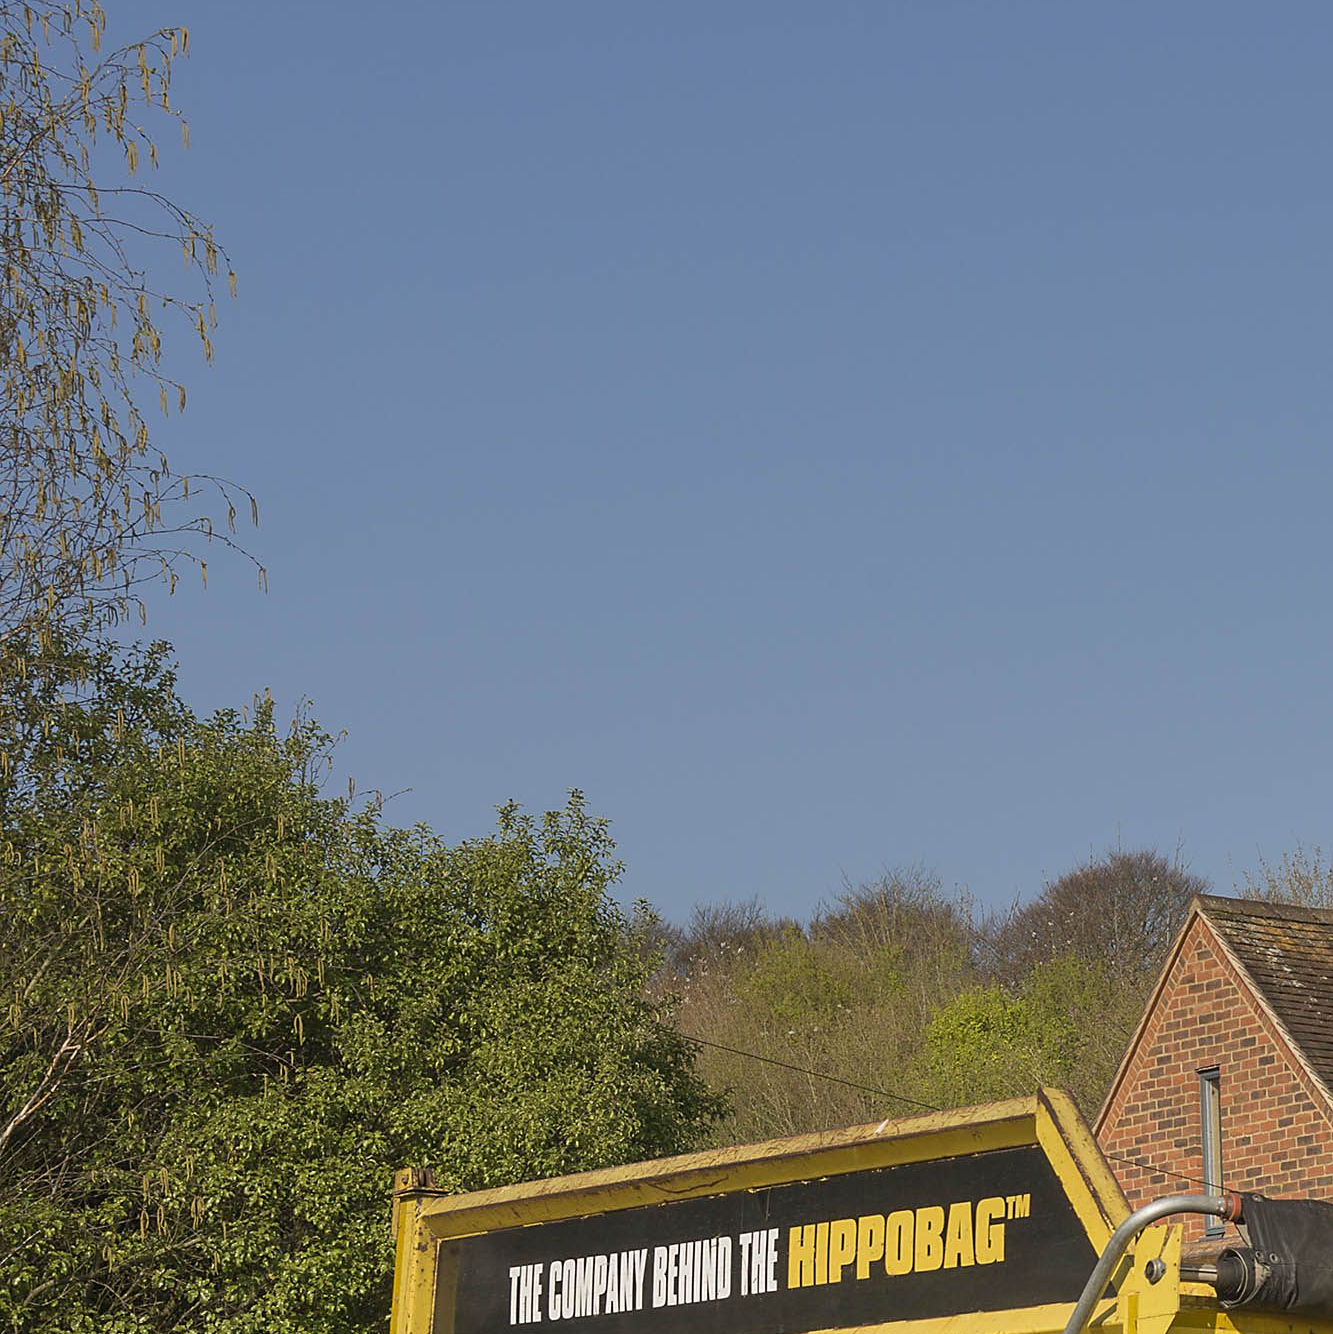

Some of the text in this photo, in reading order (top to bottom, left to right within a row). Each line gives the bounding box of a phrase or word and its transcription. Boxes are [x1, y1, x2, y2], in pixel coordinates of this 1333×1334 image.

[509, 1263, 544, 1326] THE
[547, 1248, 649, 1322] COMPANY
[652, 1236, 732, 1308] BEHIND
[739, 1227, 780, 1297] THE
